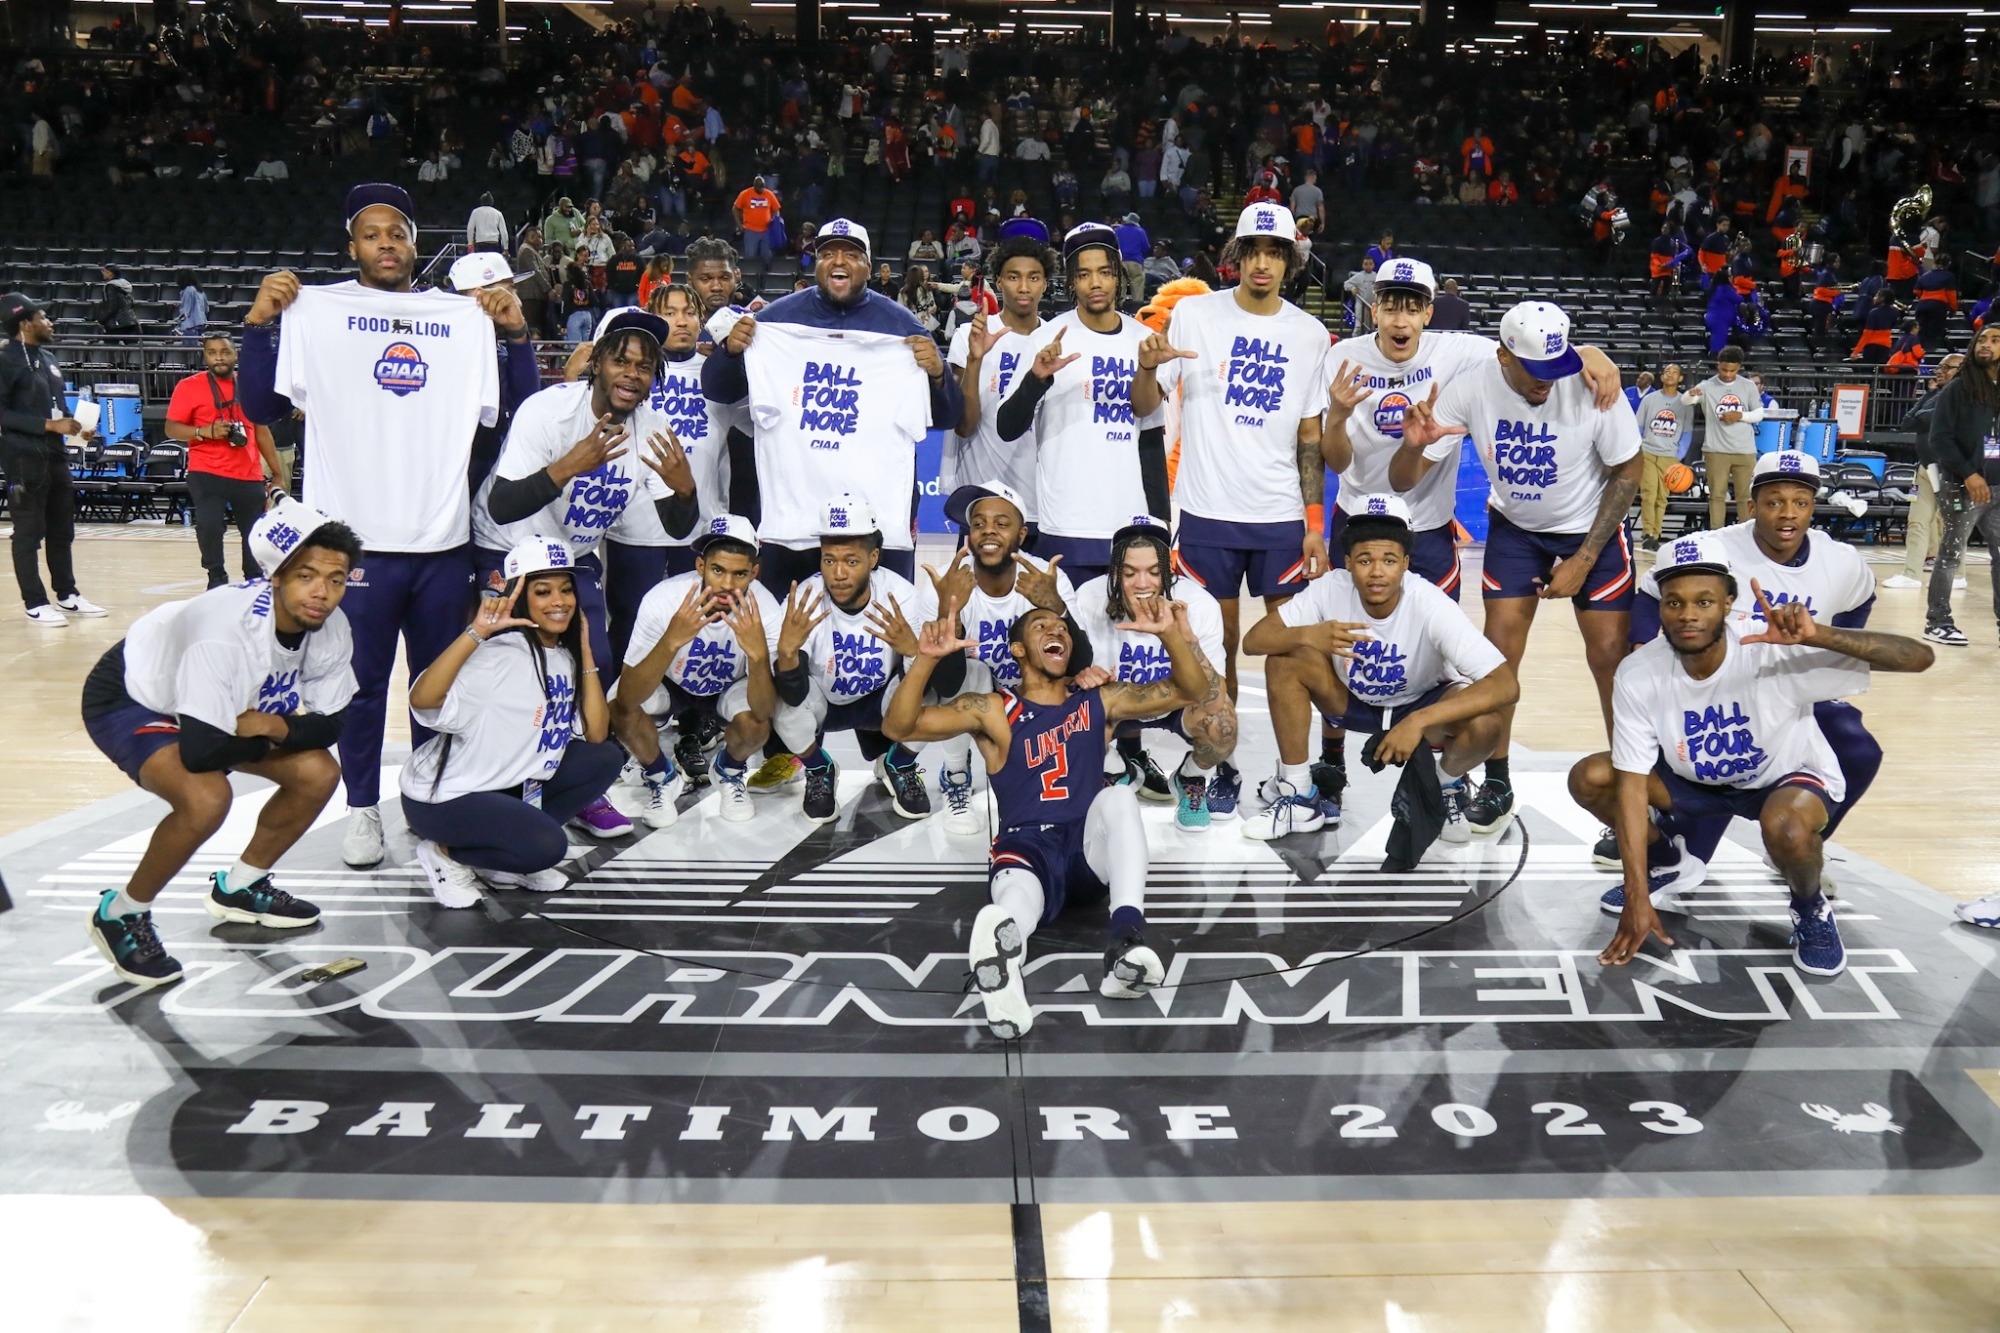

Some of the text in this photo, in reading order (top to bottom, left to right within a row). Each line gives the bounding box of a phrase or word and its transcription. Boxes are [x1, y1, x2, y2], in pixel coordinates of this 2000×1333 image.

[1256, 223, 1275, 232] MORE
[1394, 268, 1413, 276] FOUR
[1395, 262, 1414, 270] BALL
[348, 316, 450, 338] FOOD LION
[1231, 336, 1289, 363] BALL
[376, 361, 425, 381] CIAA
[803, 362, 862, 387] BALL
[1218, 360, 1227, 380] FINAL
[1228, 359, 1285, 392] FOUR
[1406, 366, 1432, 386] LION
[651, 374, 707, 396] BALL
[792, 386, 800, 406] FINAL
[1092, 378, 1133, 401] FOU
[652, 396, 709, 421] FOUR
[801, 385, 859, 414] FOUR
[1225, 383, 1283, 413] MORE
[800, 409, 858, 436] MORE
[1093, 402, 1135, 426] MOR
[1235, 415, 1265, 428] CIAA
[1375, 410, 1404, 426] CIA
[1650, 419, 1678, 432] CIAA
[669, 418, 709, 440] ORE
[1106, 431, 1132, 442] CIAA
[1495, 419, 1558, 446] BALL
[810, 439, 840, 450] CIAA
[1495, 442, 1558, 469] FOUR
[576, 462, 632, 487] ALL
[1498, 465, 1558, 488] MORE
[570, 480, 629, 510] FOUR
[1510, 491, 1542, 501] CIAA
[564, 504, 622, 530] MORE
[829, 520, 847, 528] MORE
[266, 522, 286, 542] BALL
[272, 526, 293, 549] FOUR
[547, 543, 565, 552] BALL
[548, 551, 566, 559] FOUR
[1675, 540, 1698, 550] BALL
[1675, 548, 1698, 557] FOUR
[550, 558, 568, 567] MORE
[1675, 555, 1699, 564] MORE
[1753, 589, 1818, 616] BAL
[978, 615, 1019, 643] BA
[832, 631, 883, 657] BALL
[1120, 642, 1171, 668] BALL
[1353, 640, 1407, 664] BALL
[674, 656, 685, 676] FINAL
[682, 658, 735, 680] FOUR
[835, 654, 886, 677] FOUR
[1349, 658, 1408, 684] FOUR
[545, 674, 574, 701] BAL
[831, 676, 886, 695] MORE
[1349, 679, 1408, 696] MORE
[533, 704, 543, 728] FINAL
[542, 701, 576, 729] FOU
[1684, 701, 1750, 736] BALL
[537, 727, 571, 753] MOR
[1687, 729, 1764, 762] FOUR
[1040, 743, 1069, 801] 2
[1695, 750, 1768, 780] MORE
[5, 942, 1918, 1027] TOURNAMENT
[226, 1099, 1704, 1142] BALTIMORE 2023
